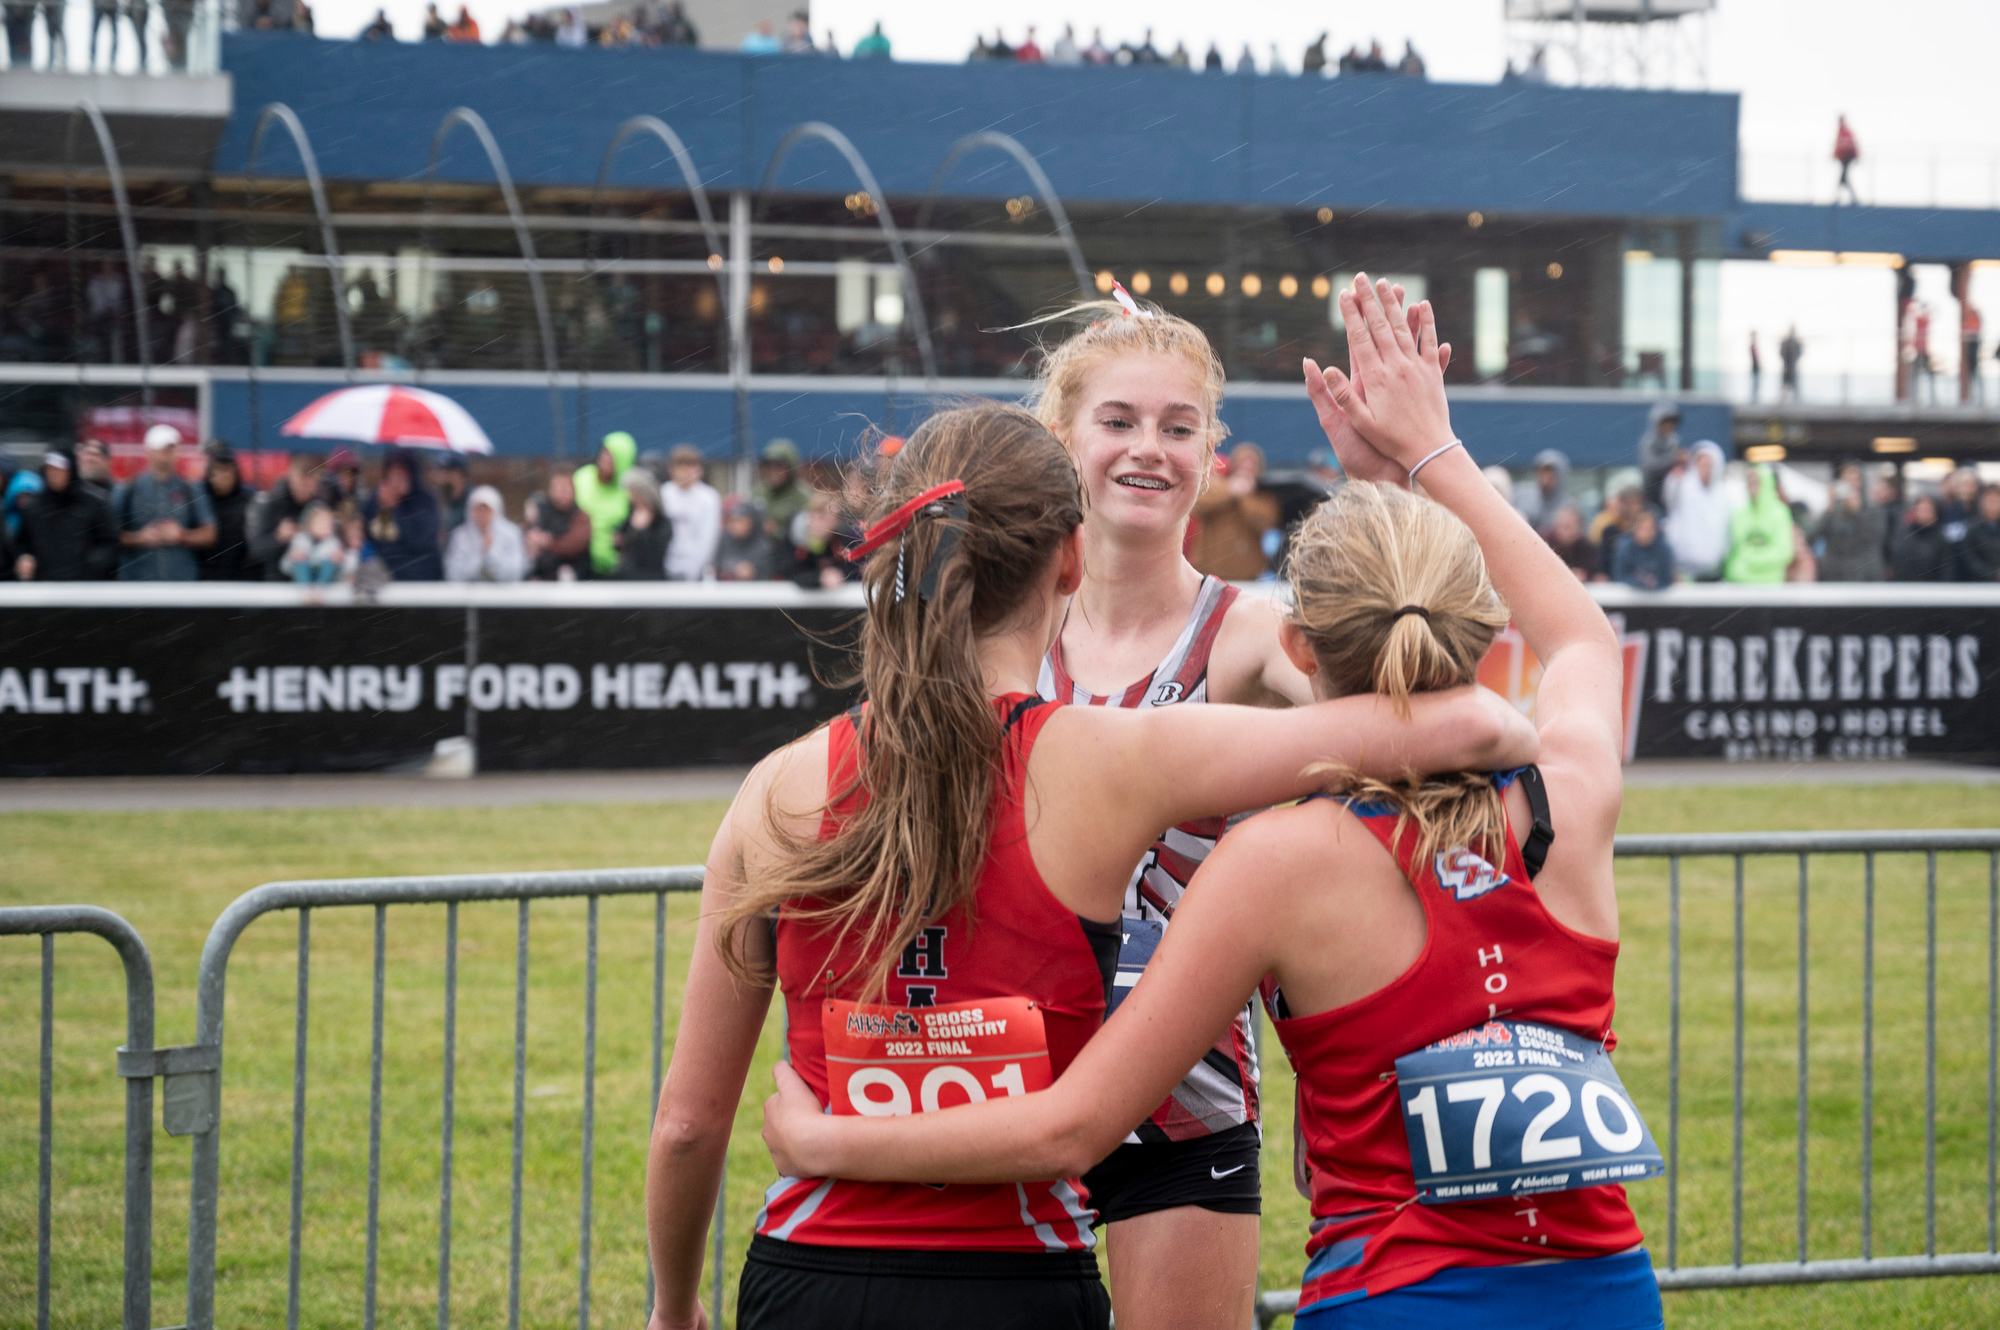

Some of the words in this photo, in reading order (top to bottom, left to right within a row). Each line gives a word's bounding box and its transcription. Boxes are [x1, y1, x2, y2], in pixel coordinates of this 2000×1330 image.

[218, 666, 419, 710] HENRY
[434, 665, 580, 709] FORD
[591, 663, 810, 708] HEALTH
[924, 1008, 984, 1027] CROSS
[927, 1019, 1007, 1039] COUNTRY
[1515, 1024, 1564, 1048] CROSS
[885, 1041, 925, 1056] 2022
[927, 1040, 972, 1055] FINAL
[1473, 1050, 1515, 1068] 2022
[1517, 1050, 1562, 1067] FINAL
[1407, 1073, 1643, 1173] 1720
[1582, 1168, 1608, 1181] WEAR
[1623, 1164, 1647, 1176] BACK
[1436, 1185, 1460, 1198] WEAR
[1475, 1182, 1498, 1194] BACK
